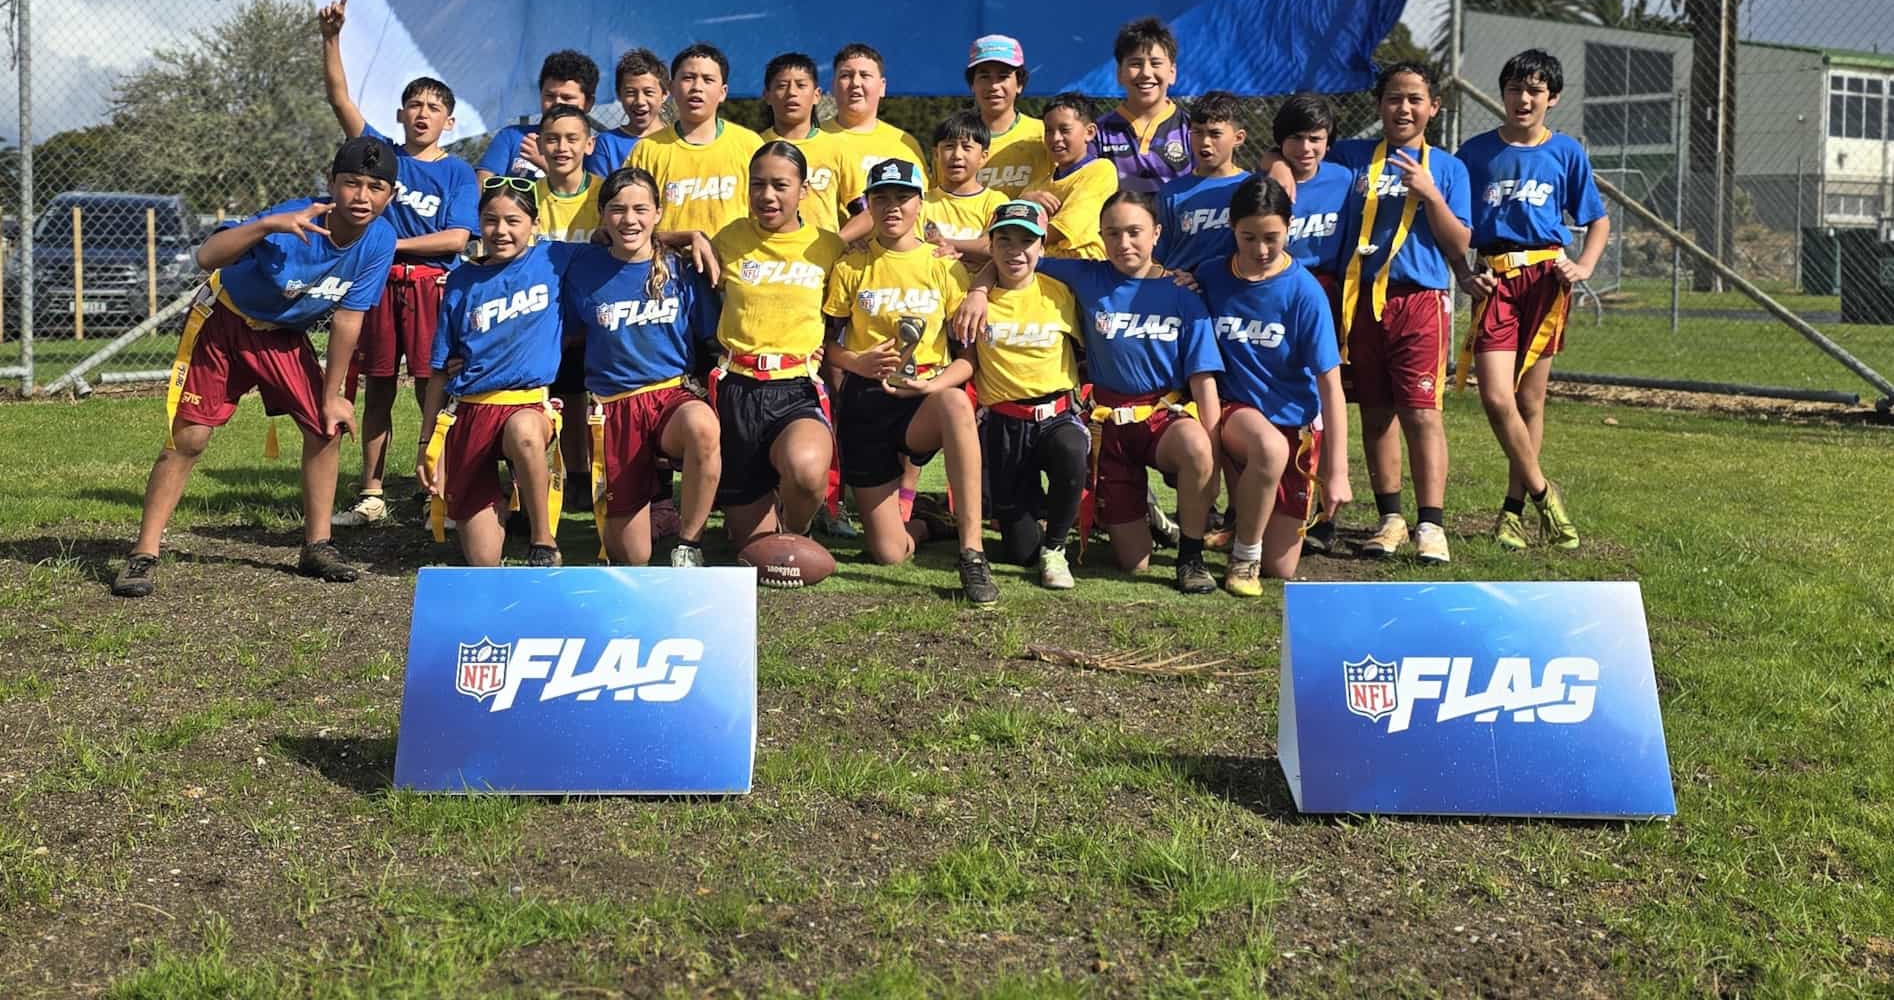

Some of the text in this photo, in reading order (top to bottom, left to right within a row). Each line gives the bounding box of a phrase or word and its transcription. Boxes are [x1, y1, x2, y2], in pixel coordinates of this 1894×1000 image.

[676, 176, 738, 207] FLAG
[1190, 207, 1231, 235] FLA
[759, 260, 825, 289] FLAG
[480, 284, 549, 333] FLAG
[609, 298, 680, 332] FLAG
[871, 286, 939, 317] FLAG
[1107, 311, 1182, 342] FLAG
[1215, 316, 1286, 348] FLAG
[462, 637, 705, 713] NFL FLAG
[1351, 656, 1600, 734] NFL FLAG
